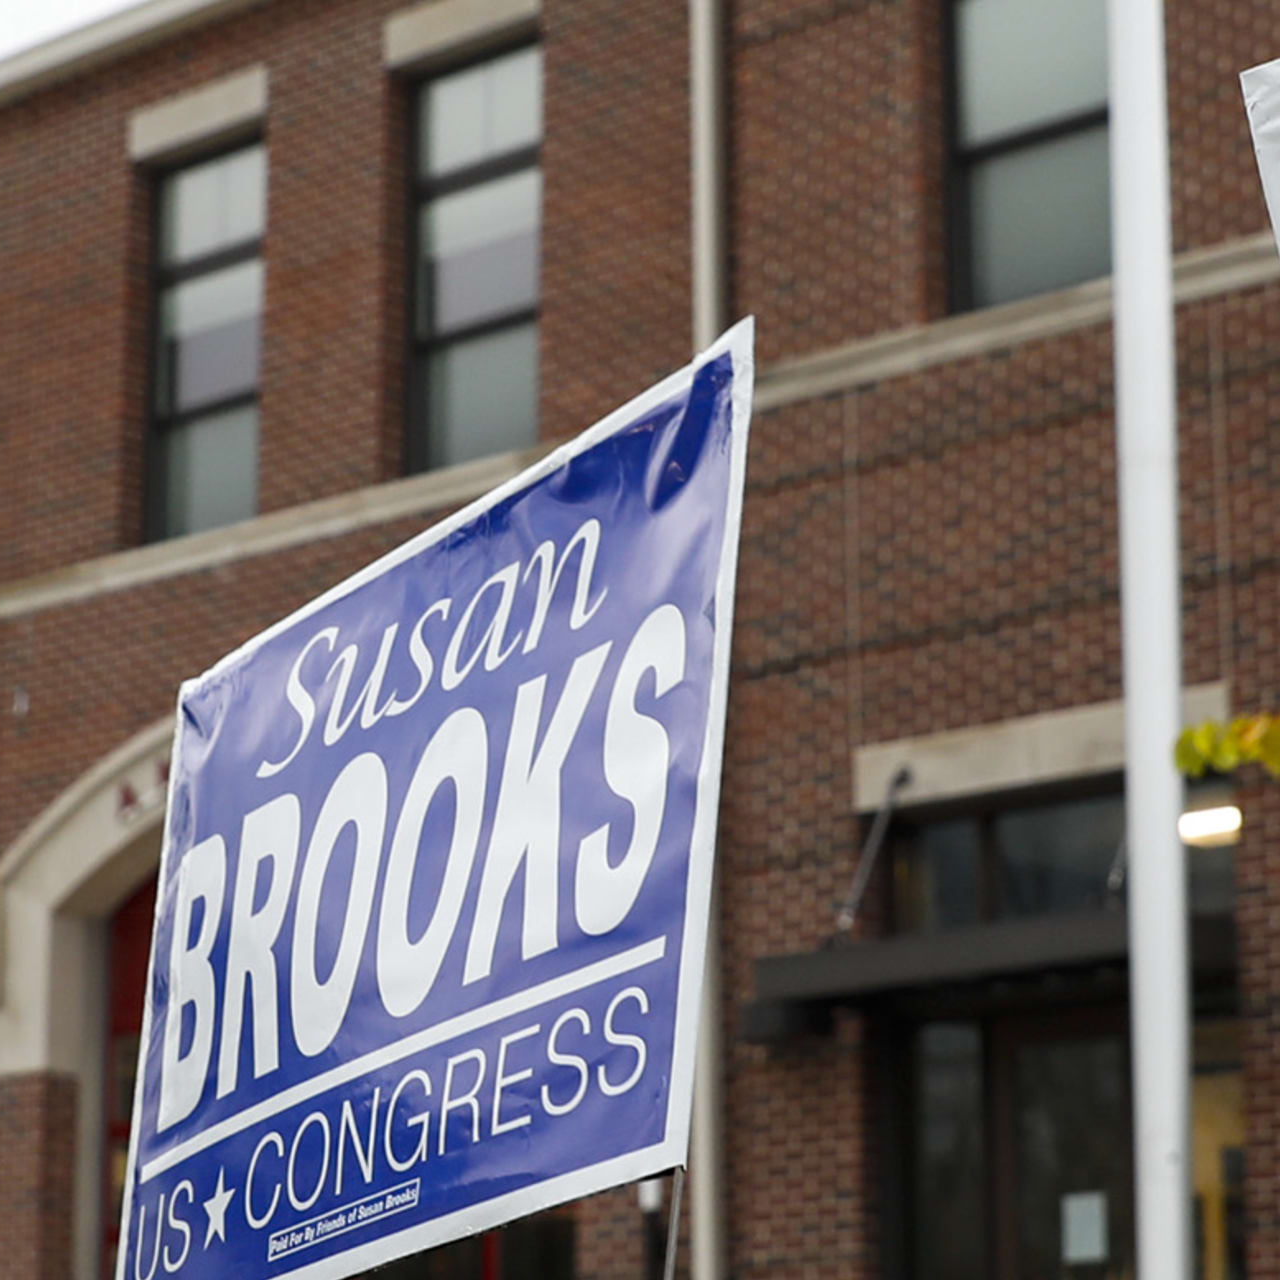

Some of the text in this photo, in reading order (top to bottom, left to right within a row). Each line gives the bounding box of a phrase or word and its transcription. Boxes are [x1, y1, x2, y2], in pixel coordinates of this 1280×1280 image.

[256, 519, 609, 778] Susan
[157, 604, 687, 1134] BROOKS
[245, 986, 649, 1230] CONGRESS
[271, 1234, 289, 1253] Paid
[290, 1230, 304, 1246] For
[316, 1213, 346, 1237] Friends
[348, 1208, 358, 1224] of
[358, 1200, 383, 1220] Susan
[385, 1187, 417, 1209] Brooks
